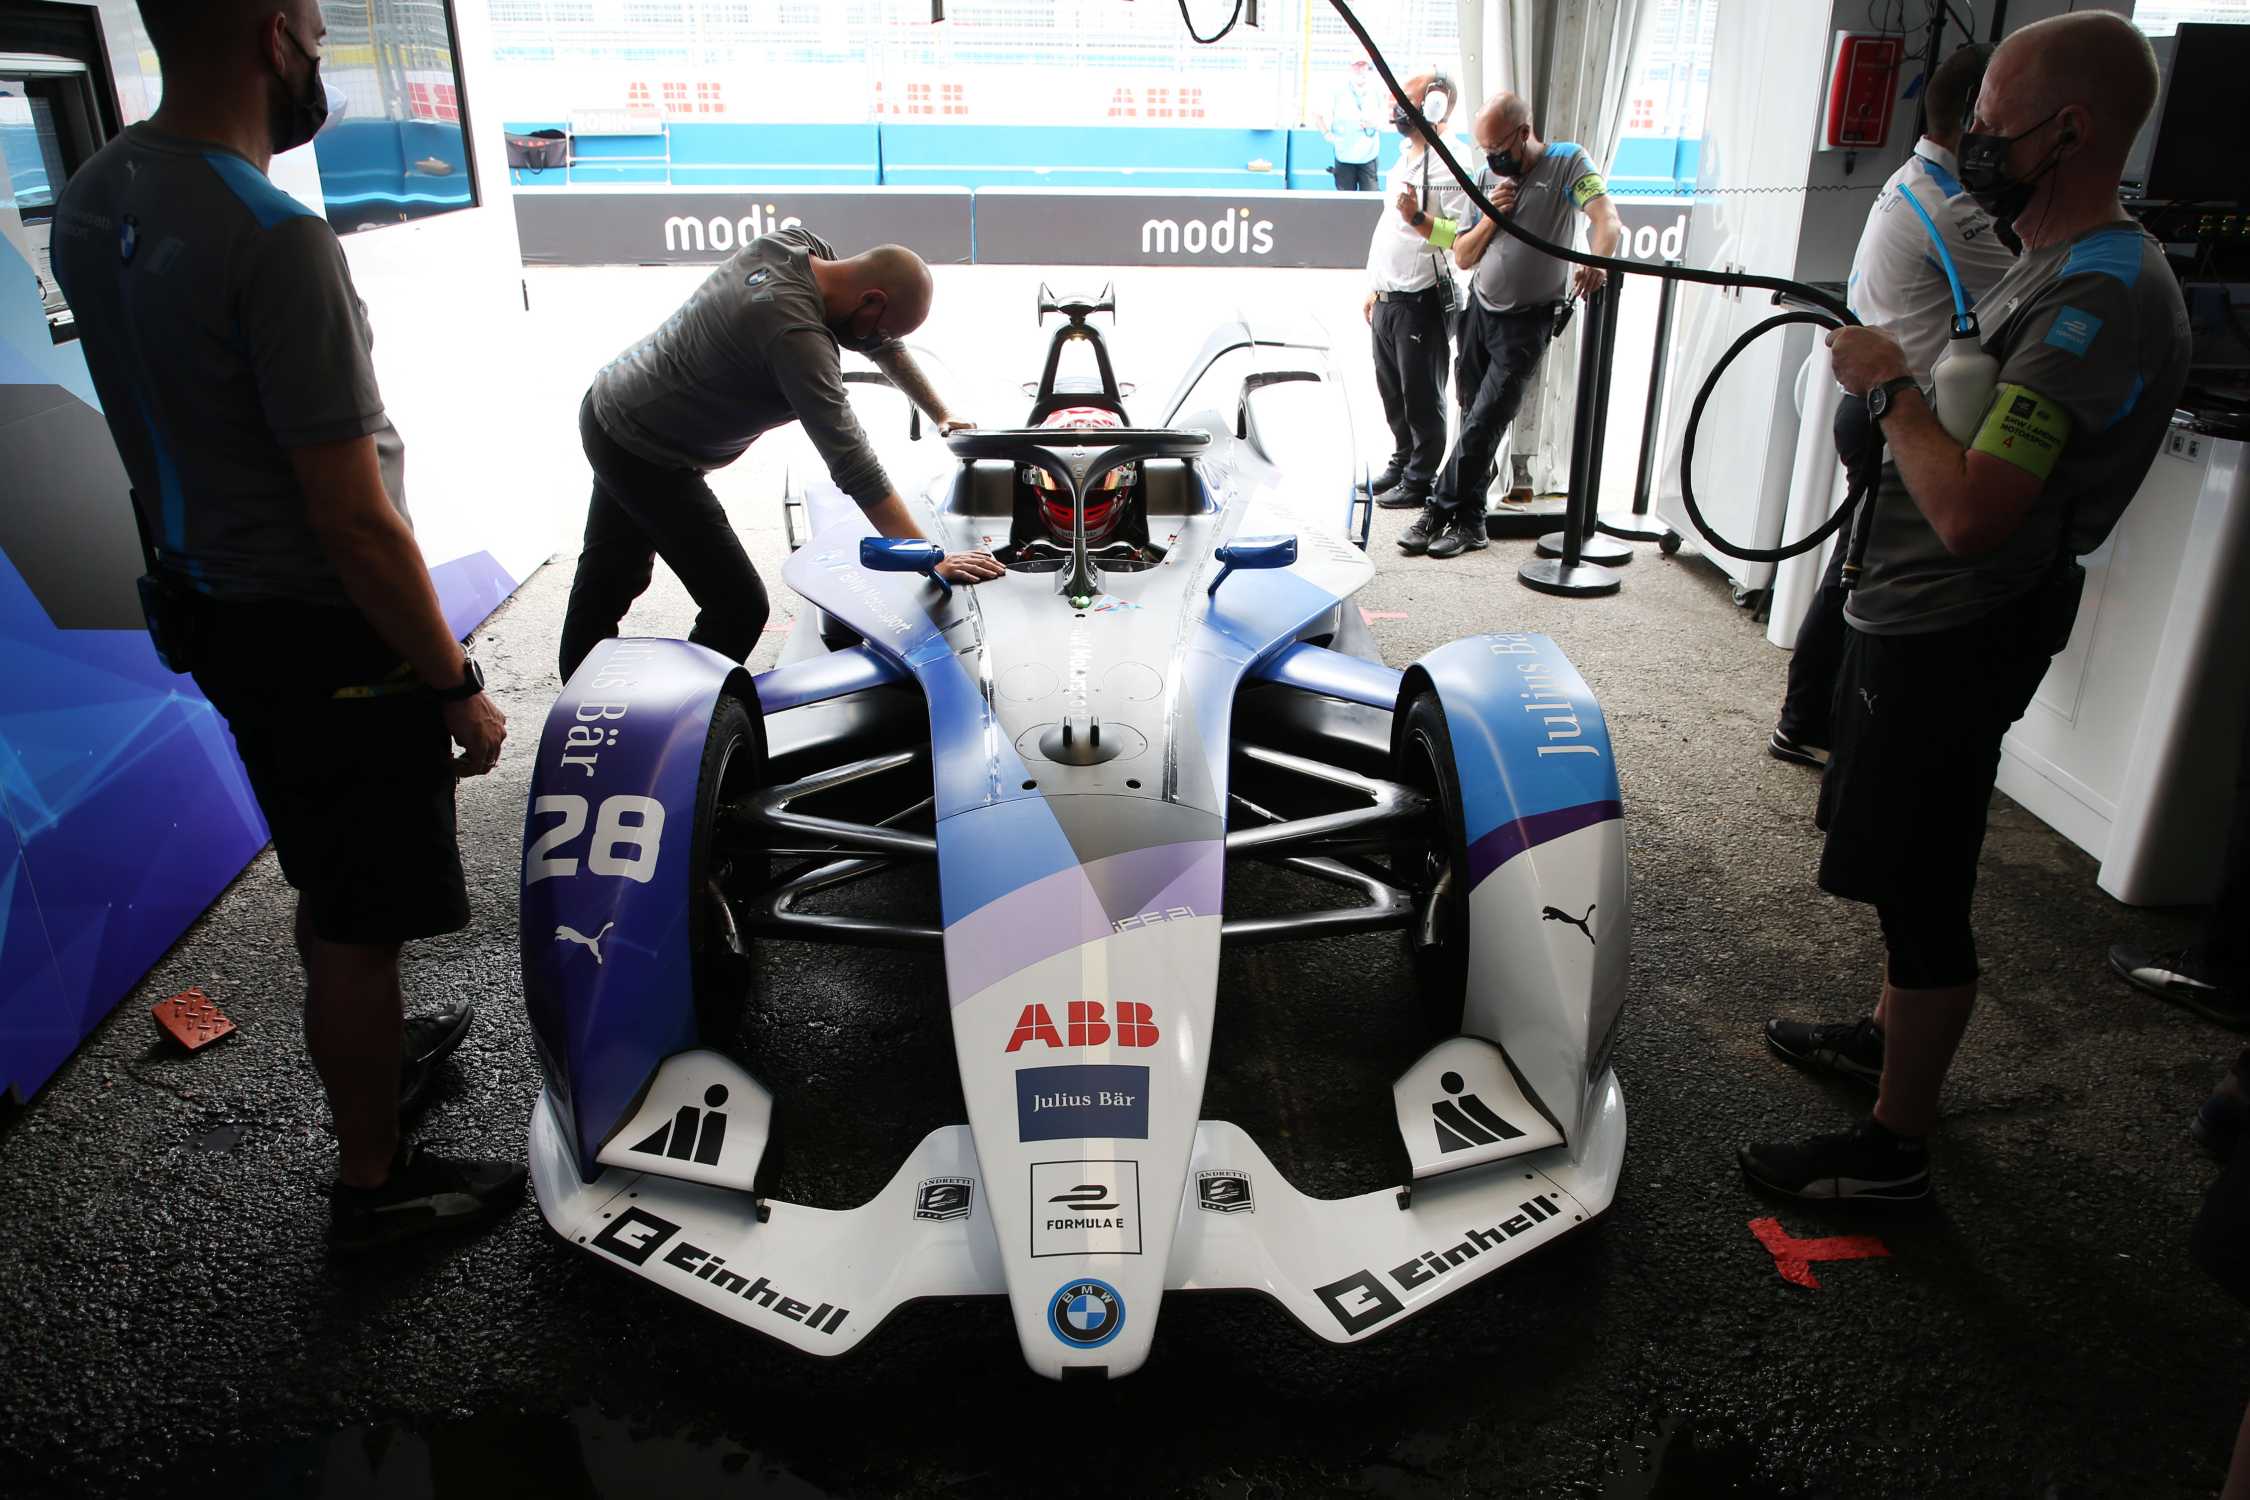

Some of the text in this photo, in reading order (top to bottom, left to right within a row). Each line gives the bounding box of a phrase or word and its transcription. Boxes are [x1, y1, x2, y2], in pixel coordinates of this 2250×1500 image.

[1142, 208, 1274, 254] modis
[560, 701, 629, 778] Bär
[1516, 663, 1601, 758] Julius
[526, 794, 667, 887] 28
[1004, 1000, 1160, 1053] ABB
[1033, 1090, 1136, 1113] Julius Bär
[1046, 1218, 1124, 1231] FORMULA E
[1388, 1194, 1562, 1292] Einhell
[662, 1241, 851, 1336] Einhell
[1062, 1285, 1114, 1304] BMW
